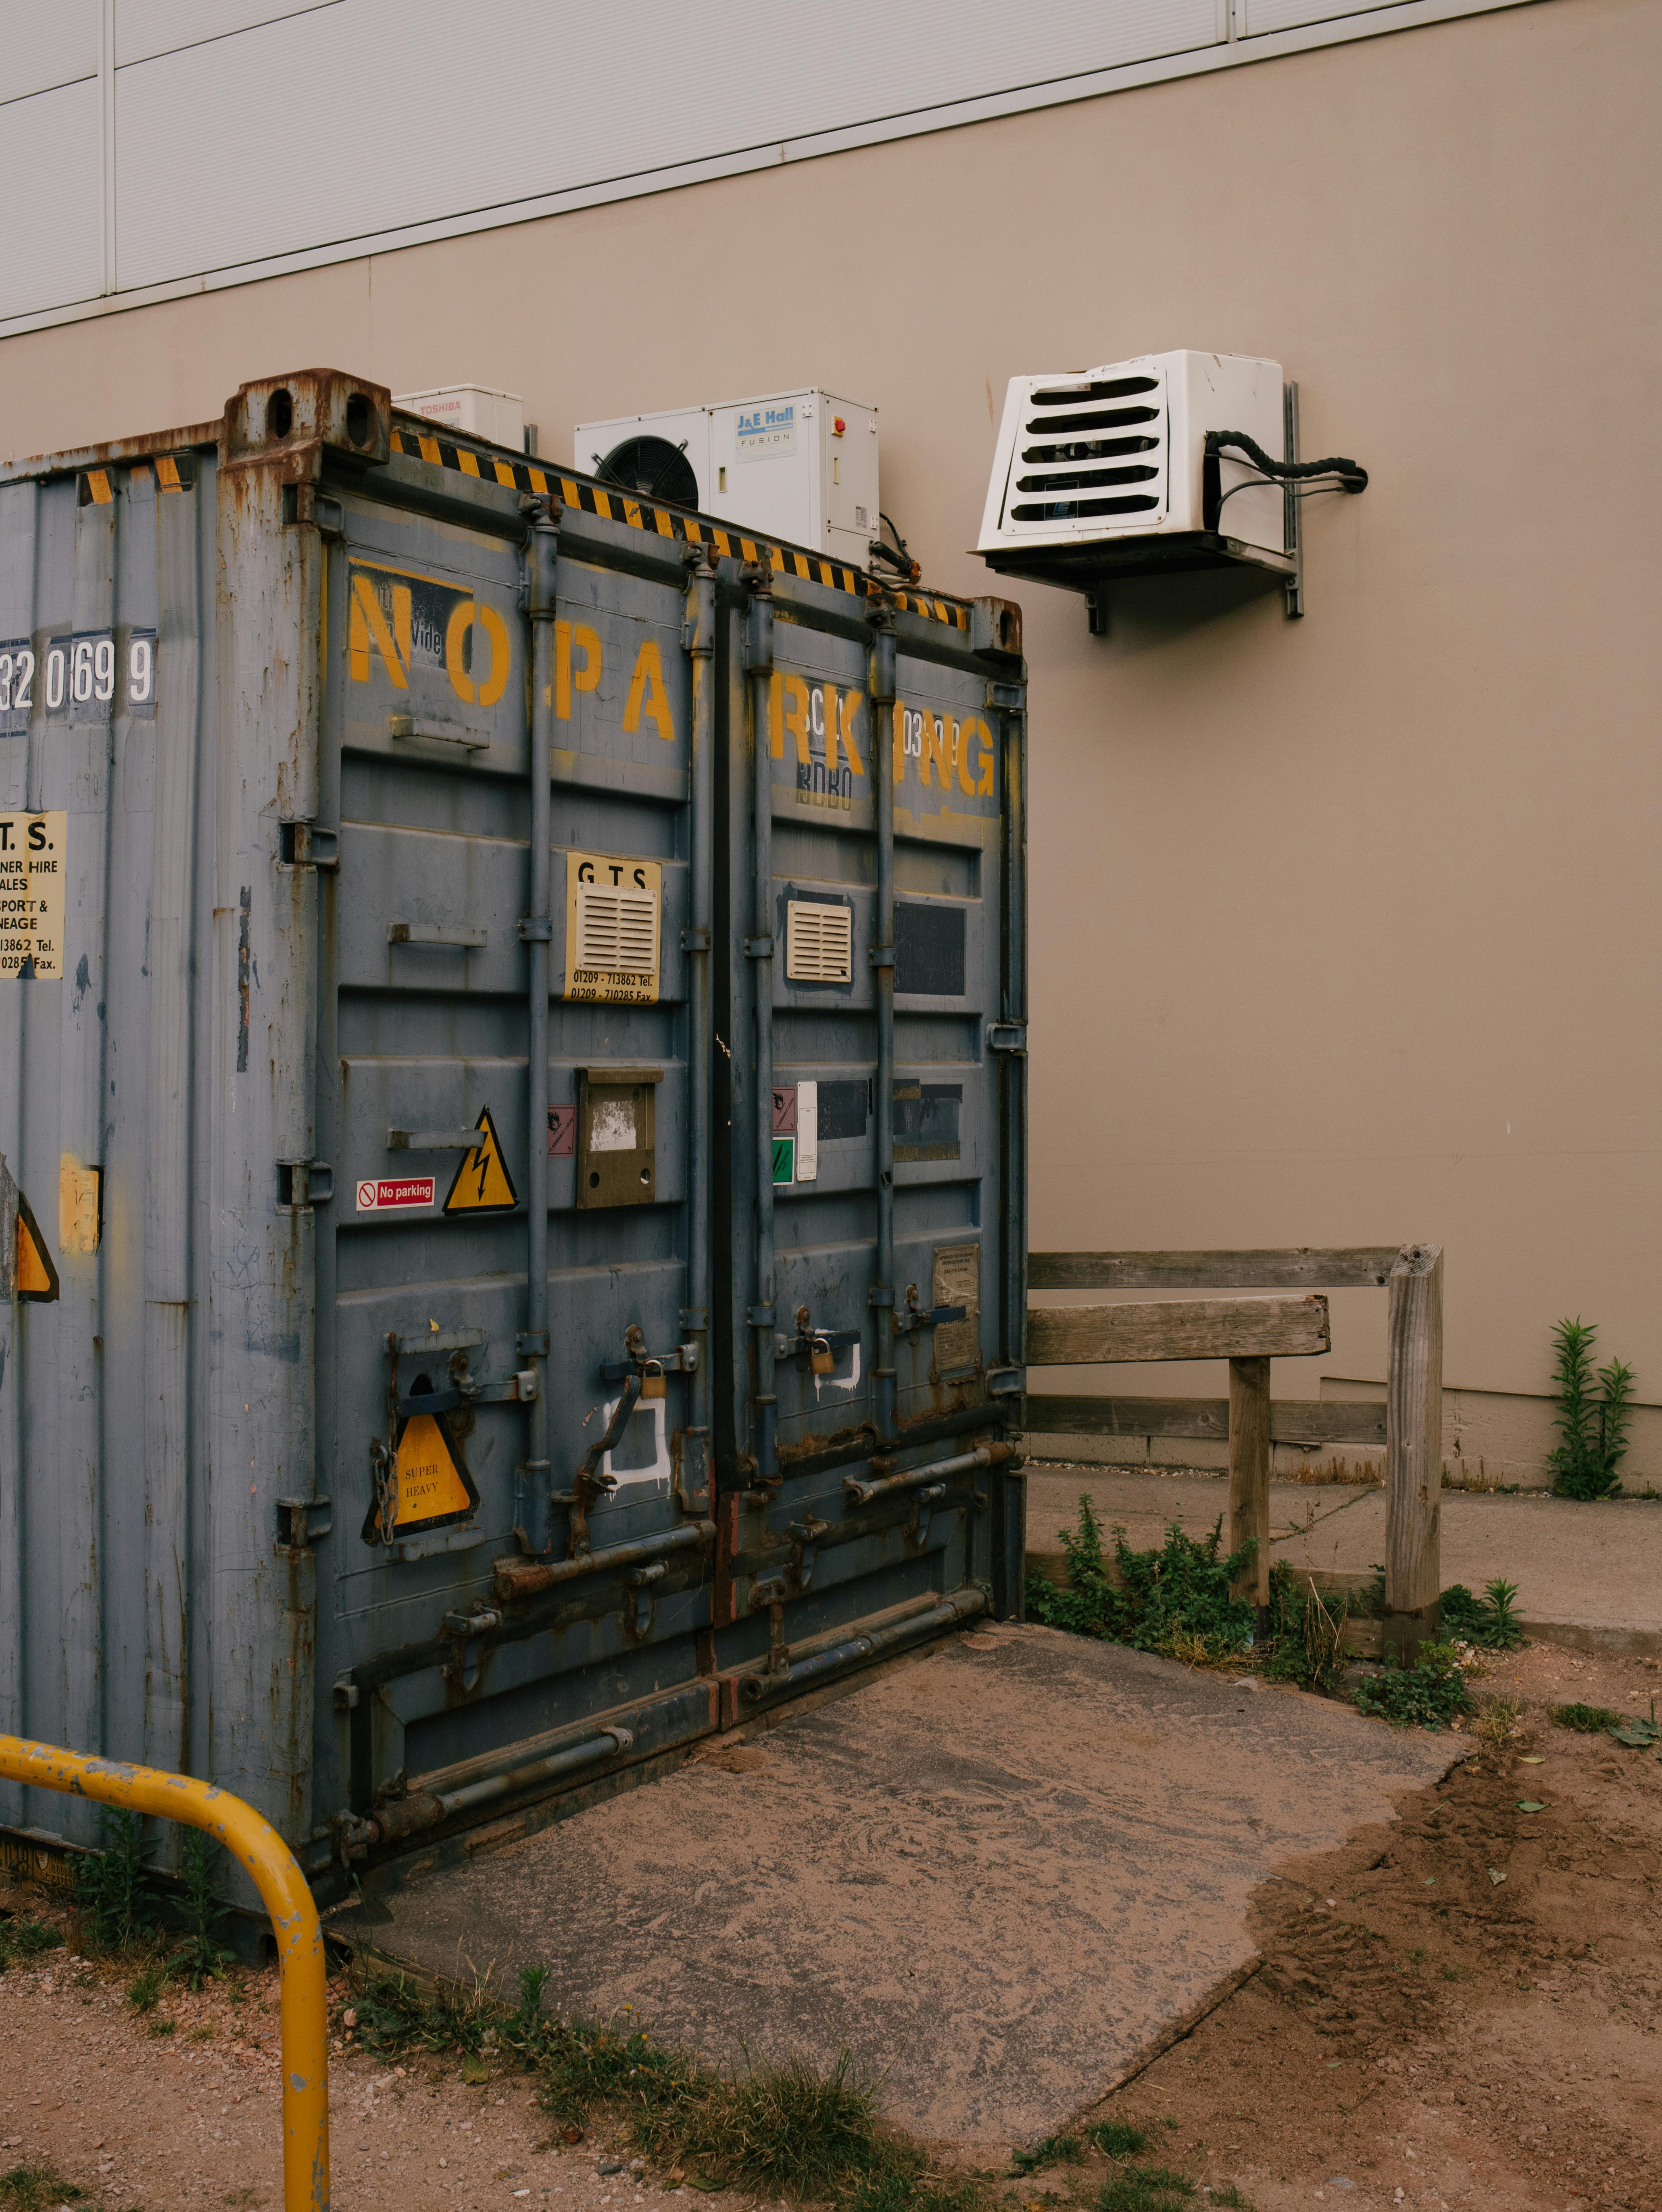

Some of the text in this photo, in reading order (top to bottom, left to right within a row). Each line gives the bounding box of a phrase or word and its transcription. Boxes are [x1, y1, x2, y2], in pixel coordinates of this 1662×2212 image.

[420, 401, 461, 415] TOSHIBA
[738, 407, 793, 429] J&E Hall
[742, 434, 789, 446] FUSION
[350, 575, 509, 707] NO
[29, 861, 57, 873] HIRE
[0, 900, 48, 912] PORT &
[36, 939, 54, 951] Tel.
[34, 957, 55, 969] Fax.
[573, 970, 598, 983] 01209
[607, 973, 636, 986] 713862
[639, 975, 652, 987] Tel.
[571, 987, 596, 999] 01209
[605, 989, 634, 1001] 710285
[635, 991, 653, 1002] Fax.
[776, 1109, 788, 1129] FLAMMABLE
[548, 1129, 565, 1153] FLAMMABLE
[380, 1184, 431, 1201] No parking
[405, 1464, 438, 1480] SUPER
[407, 1482, 438, 1498] HEAVY
